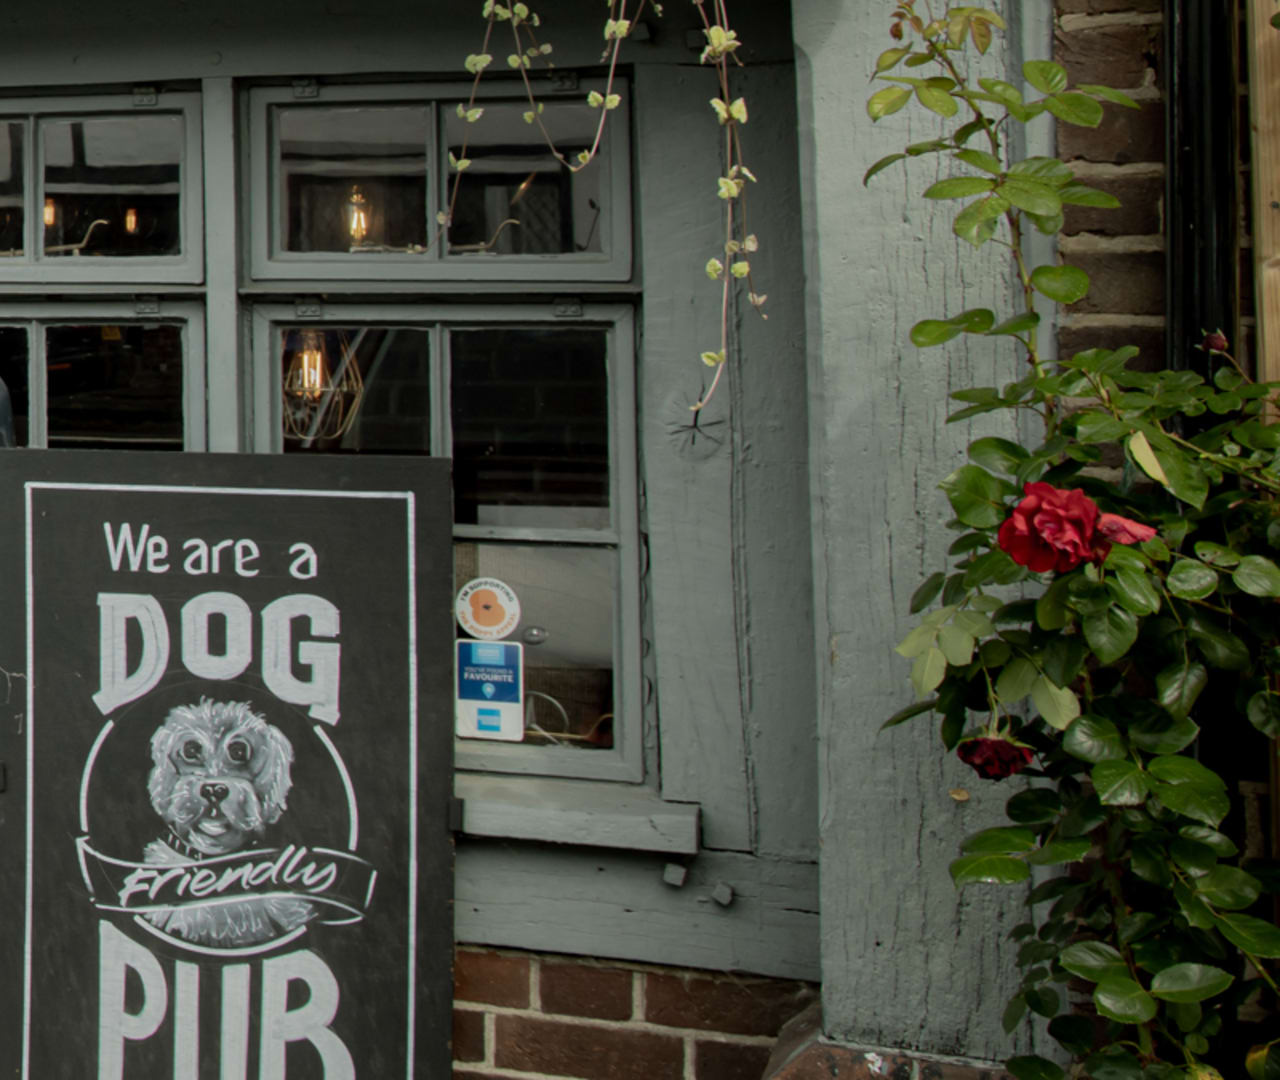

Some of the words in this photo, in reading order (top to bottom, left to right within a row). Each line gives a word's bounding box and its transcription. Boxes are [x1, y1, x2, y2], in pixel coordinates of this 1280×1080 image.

[103, 522, 170, 573] We
[183, 537, 260, 577] are
[288, 542, 318, 579] a
[92, 591, 341, 726] DOG
[463, 671, 515, 684] FAVOURITE
[117, 844, 337, 908] Friendly
[98, 919, 357, 1080] PUB
